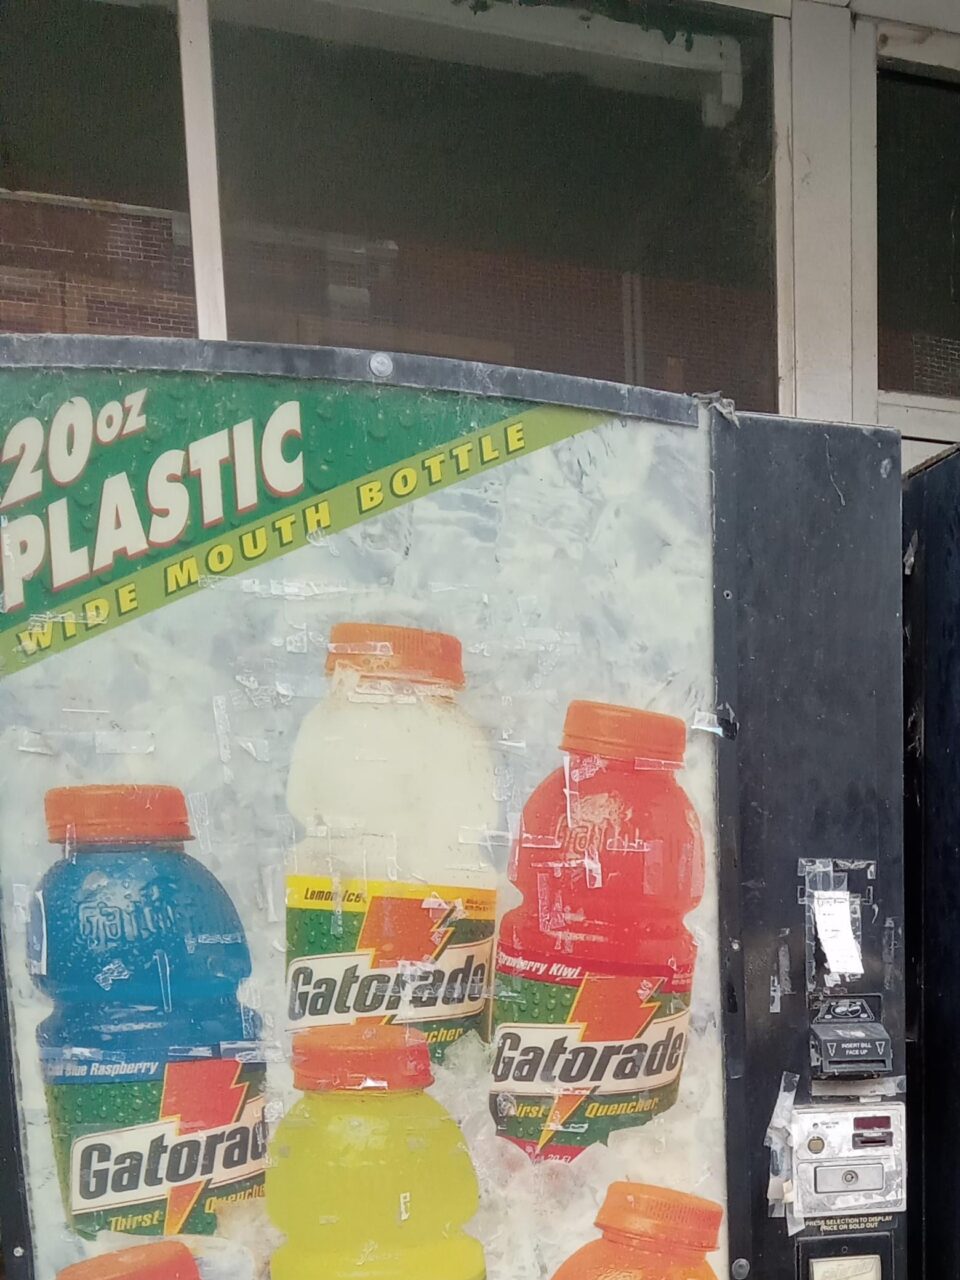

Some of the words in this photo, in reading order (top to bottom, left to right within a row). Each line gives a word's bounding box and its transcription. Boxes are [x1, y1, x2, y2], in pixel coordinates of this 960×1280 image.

[0, 400, 304, 612] PLASTIC
[18, 583, 138, 655] WIDE
[164, 501, 331, 595] MOUTH
[357, 421, 525, 514] BOTTLE
[341, 889, 363, 903] Ice
[548, 962, 582, 979] Kiwi
[288, 955, 486, 1021] Gatorade
[492, 1026, 685, 1083] Gatorade
[90, 1061, 159, 1077] Raspberry
[109, 1209, 160, 1232] Thirst
[806, 1219, 825, 1227] PRESS
[826, 1217, 859, 1225] SELECTION
